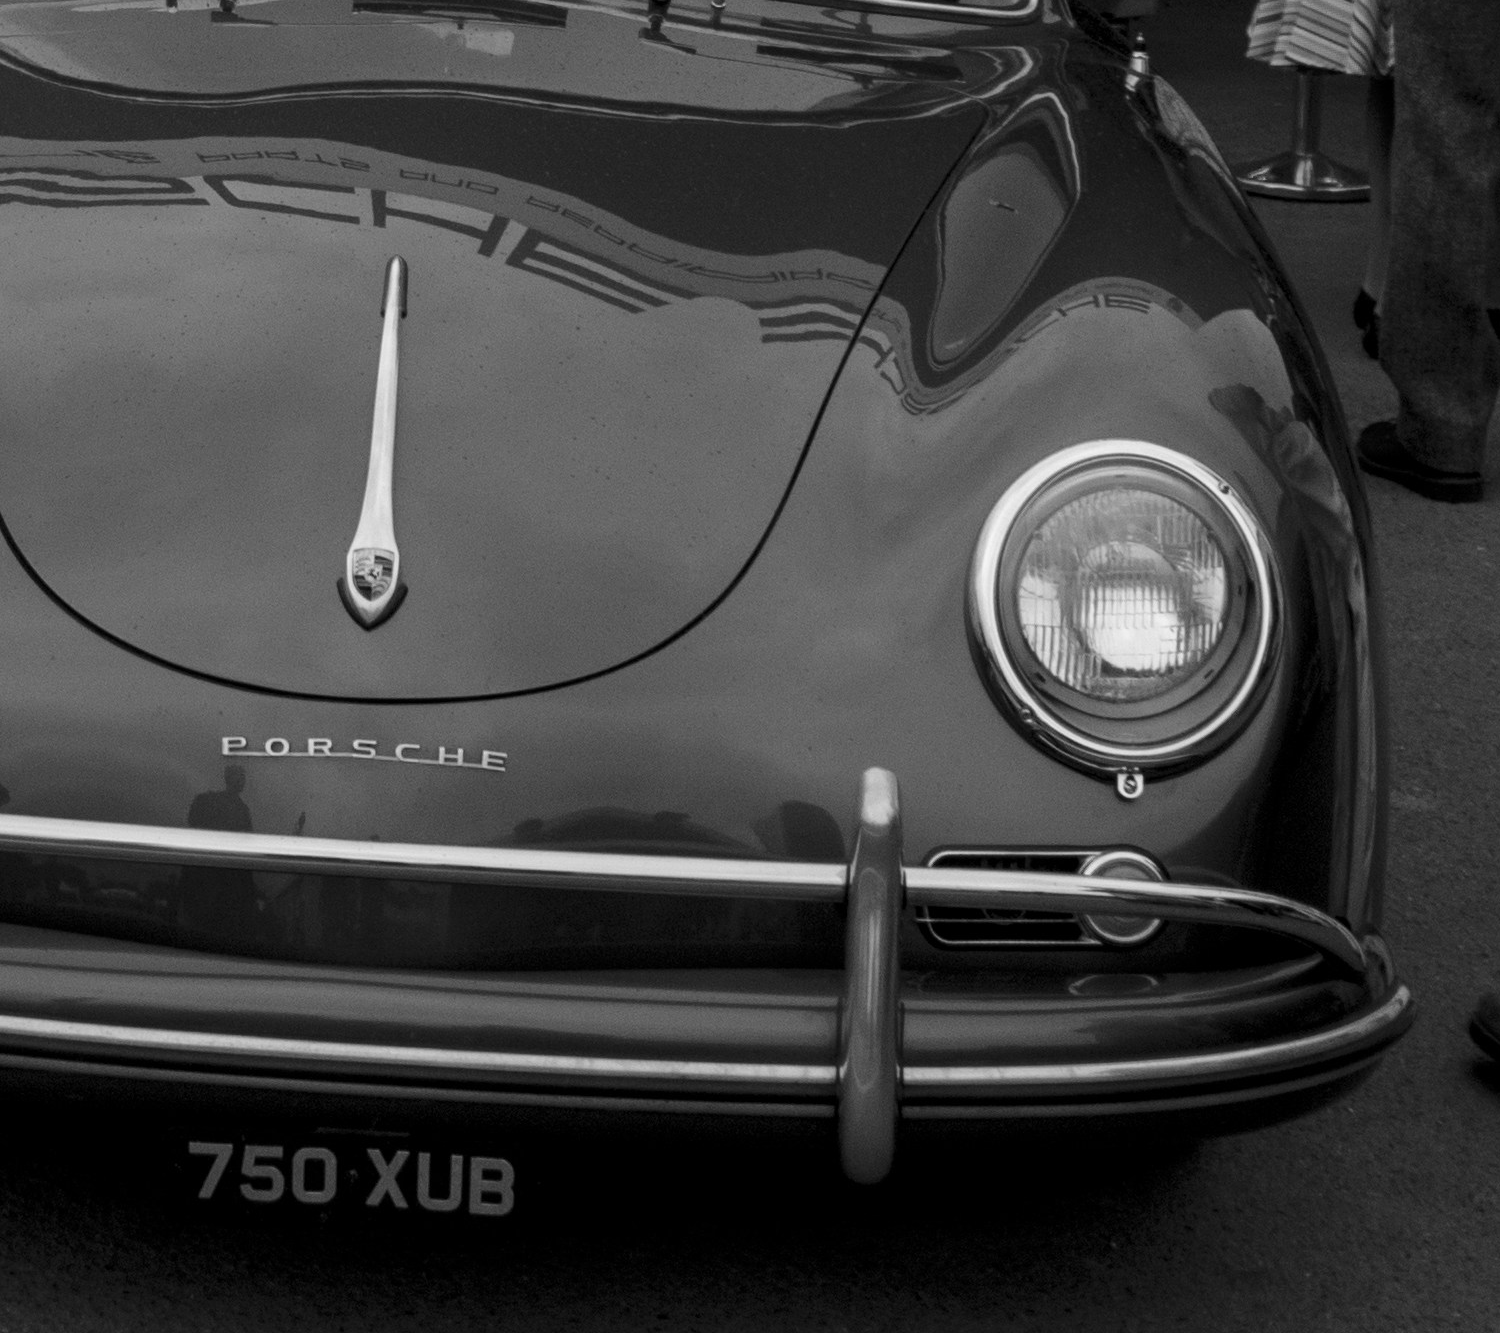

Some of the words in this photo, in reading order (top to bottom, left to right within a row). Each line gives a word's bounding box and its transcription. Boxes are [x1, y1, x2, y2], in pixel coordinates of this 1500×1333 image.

[220, 736, 508, 771] PORSCHE
[188, 1140, 338, 1204] 750
[365, 1148, 516, 1216] XUB
